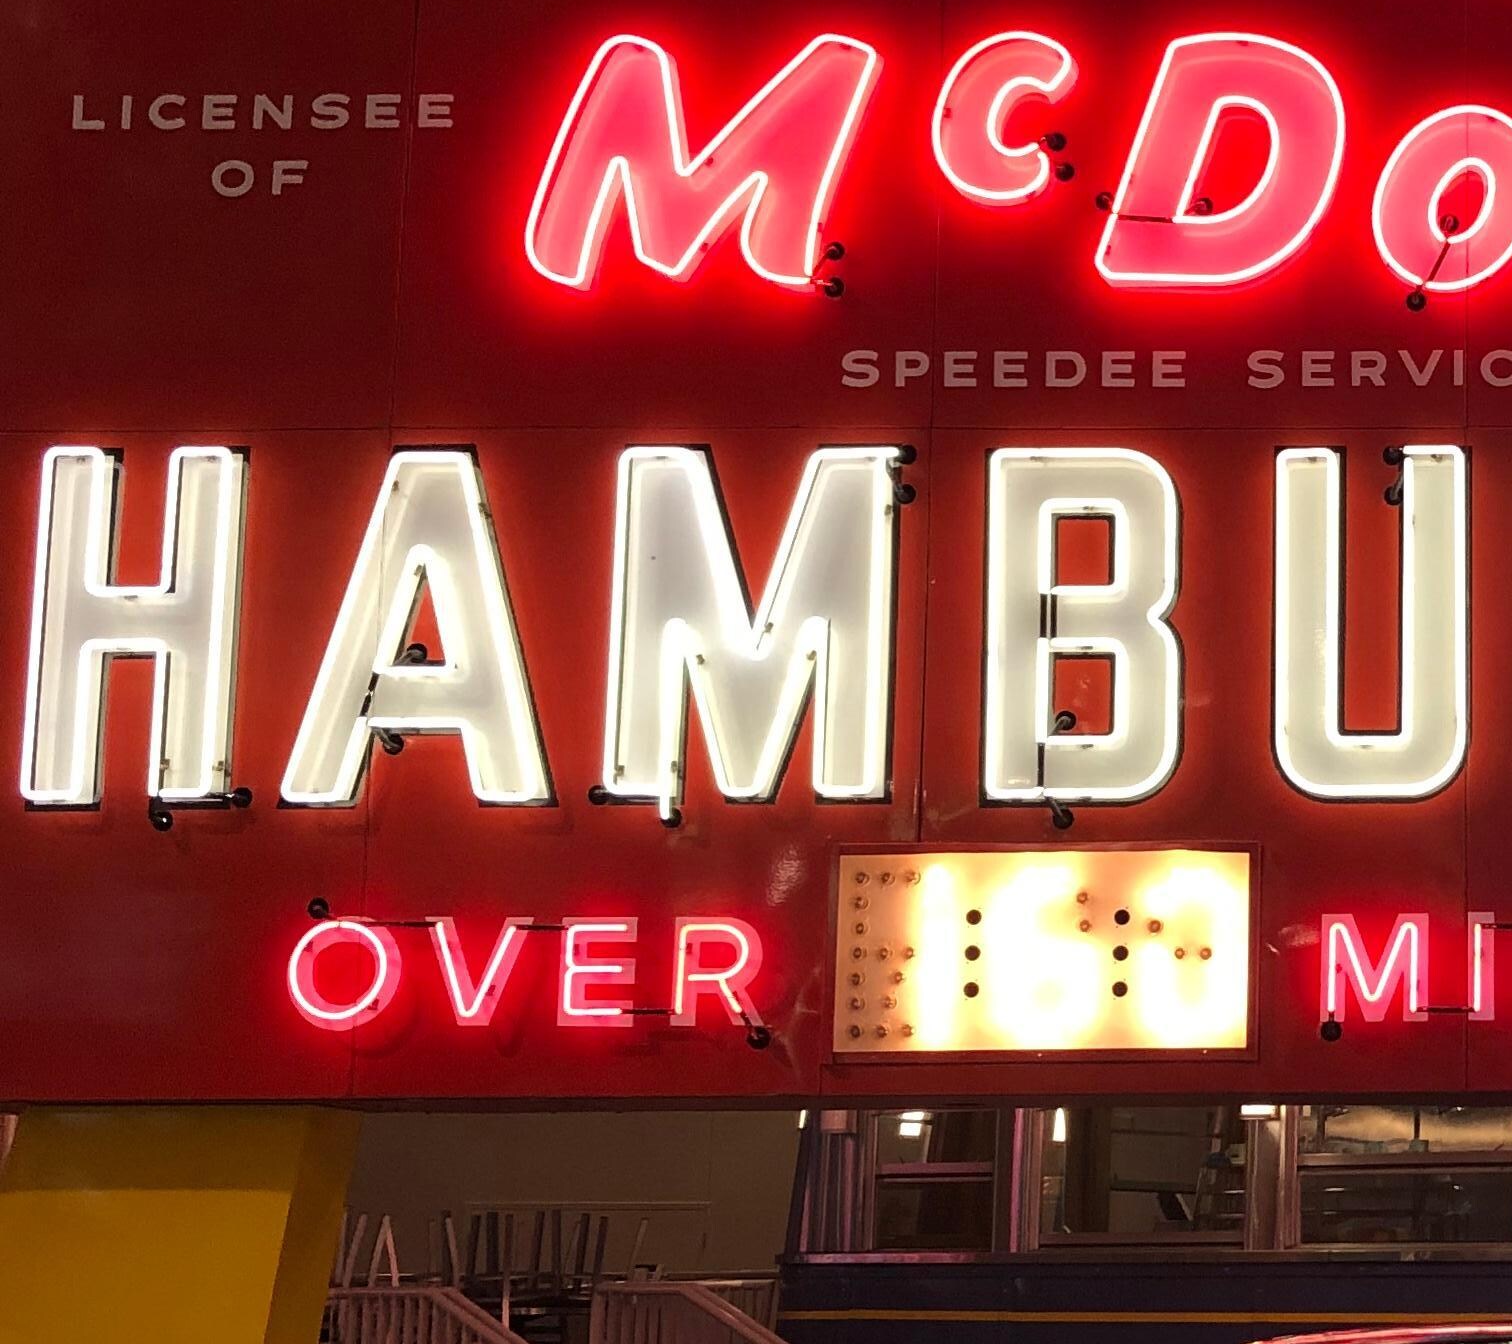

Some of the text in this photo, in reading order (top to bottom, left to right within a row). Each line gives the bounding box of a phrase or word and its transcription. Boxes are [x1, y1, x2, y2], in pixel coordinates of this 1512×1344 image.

[72, 93, 454, 131] LICENSEE
[211, 159, 309, 197] OF
[841, 348, 1187, 389] SPEEDEE
[287, 915, 764, 1031] OVER
